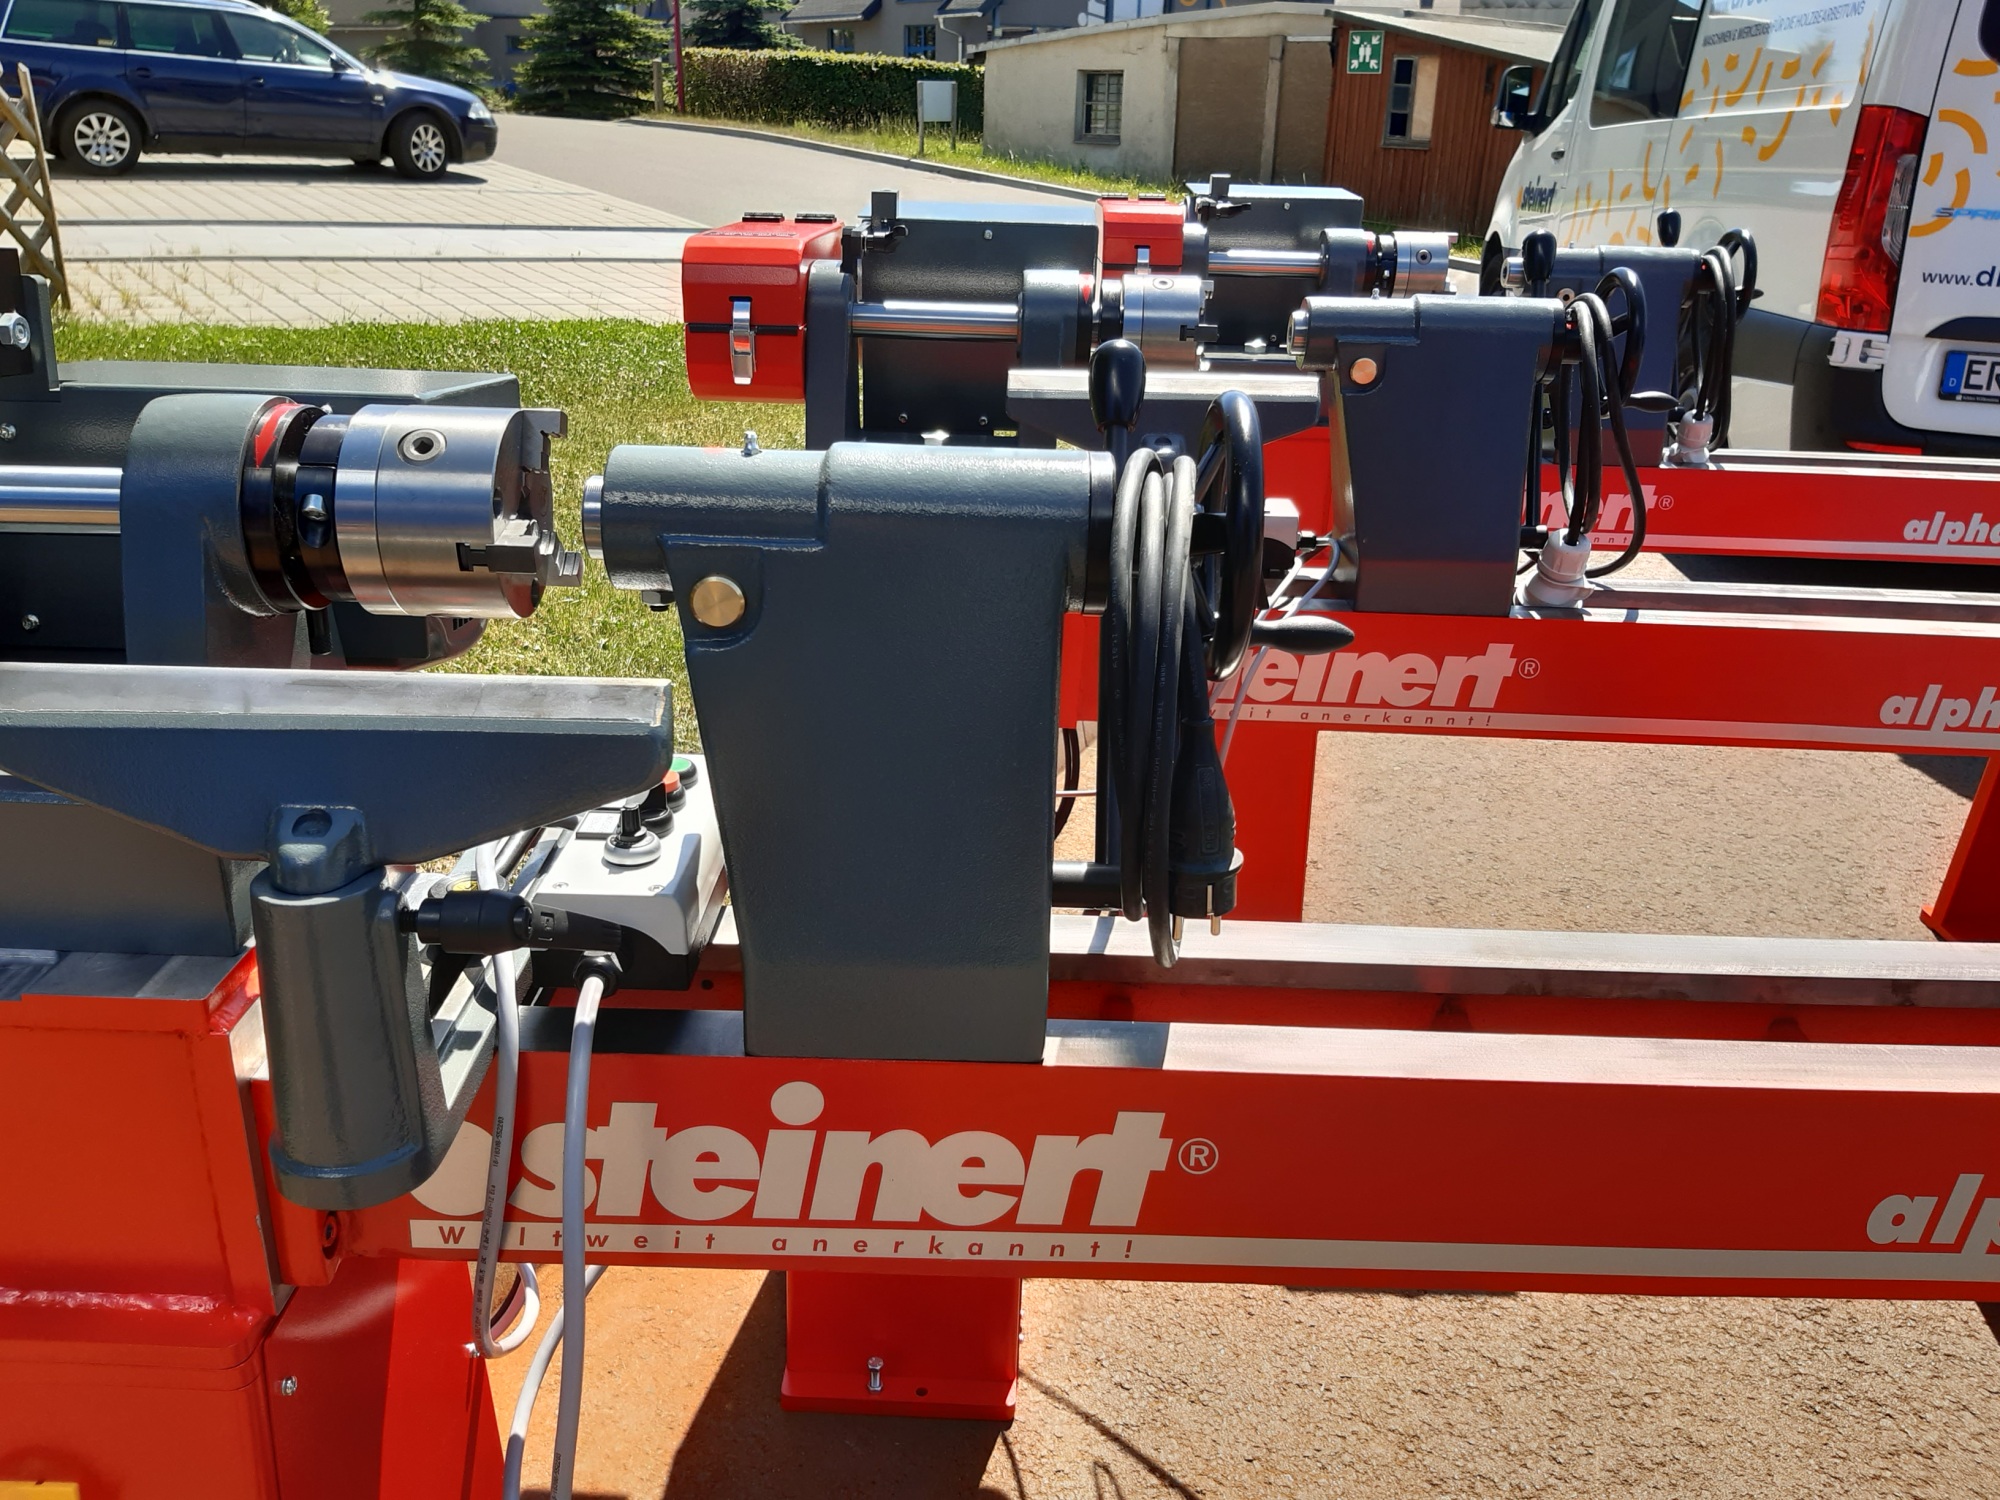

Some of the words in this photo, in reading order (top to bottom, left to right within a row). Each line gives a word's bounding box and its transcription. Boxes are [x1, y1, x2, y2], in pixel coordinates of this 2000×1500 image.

[1520, 175, 1557, 213] steinert
[1948, 377, 1957, 387] D
[1300, 710, 1491, 727] anerkannt!
[438, 1226, 715, 1250] Wltweit
[771, 1235, 1133, 1259] anerkannt!
